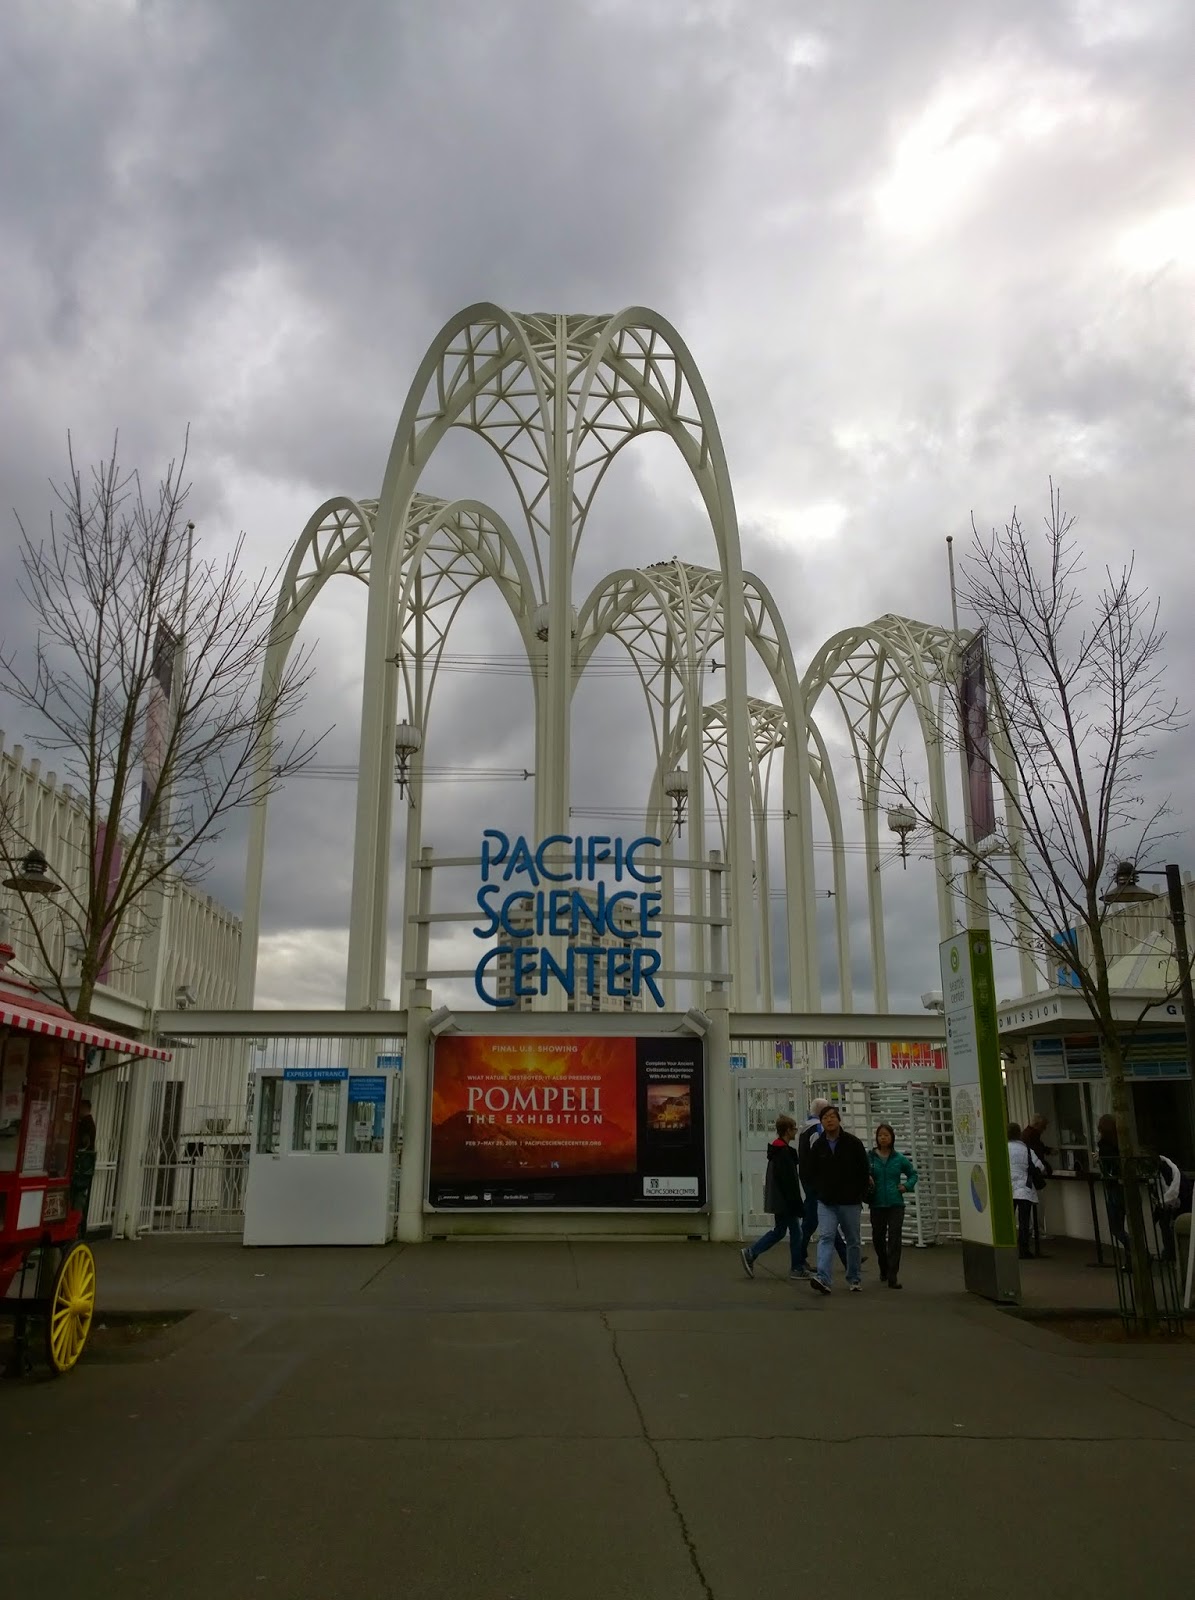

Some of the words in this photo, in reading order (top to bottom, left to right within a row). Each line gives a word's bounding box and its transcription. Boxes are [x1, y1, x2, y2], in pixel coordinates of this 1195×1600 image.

[481, 830, 662, 886] PACIFIC
[473, 881, 662, 938] SCIENCE
[474, 946, 665, 1008] CENTER
[999, 1003, 1058, 1028] DMISSION
[466, 1086, 602, 1112] POMPEII
[466, 1115, 495, 1124] THE
[506, 1115, 603, 1124] EXHIBITION
